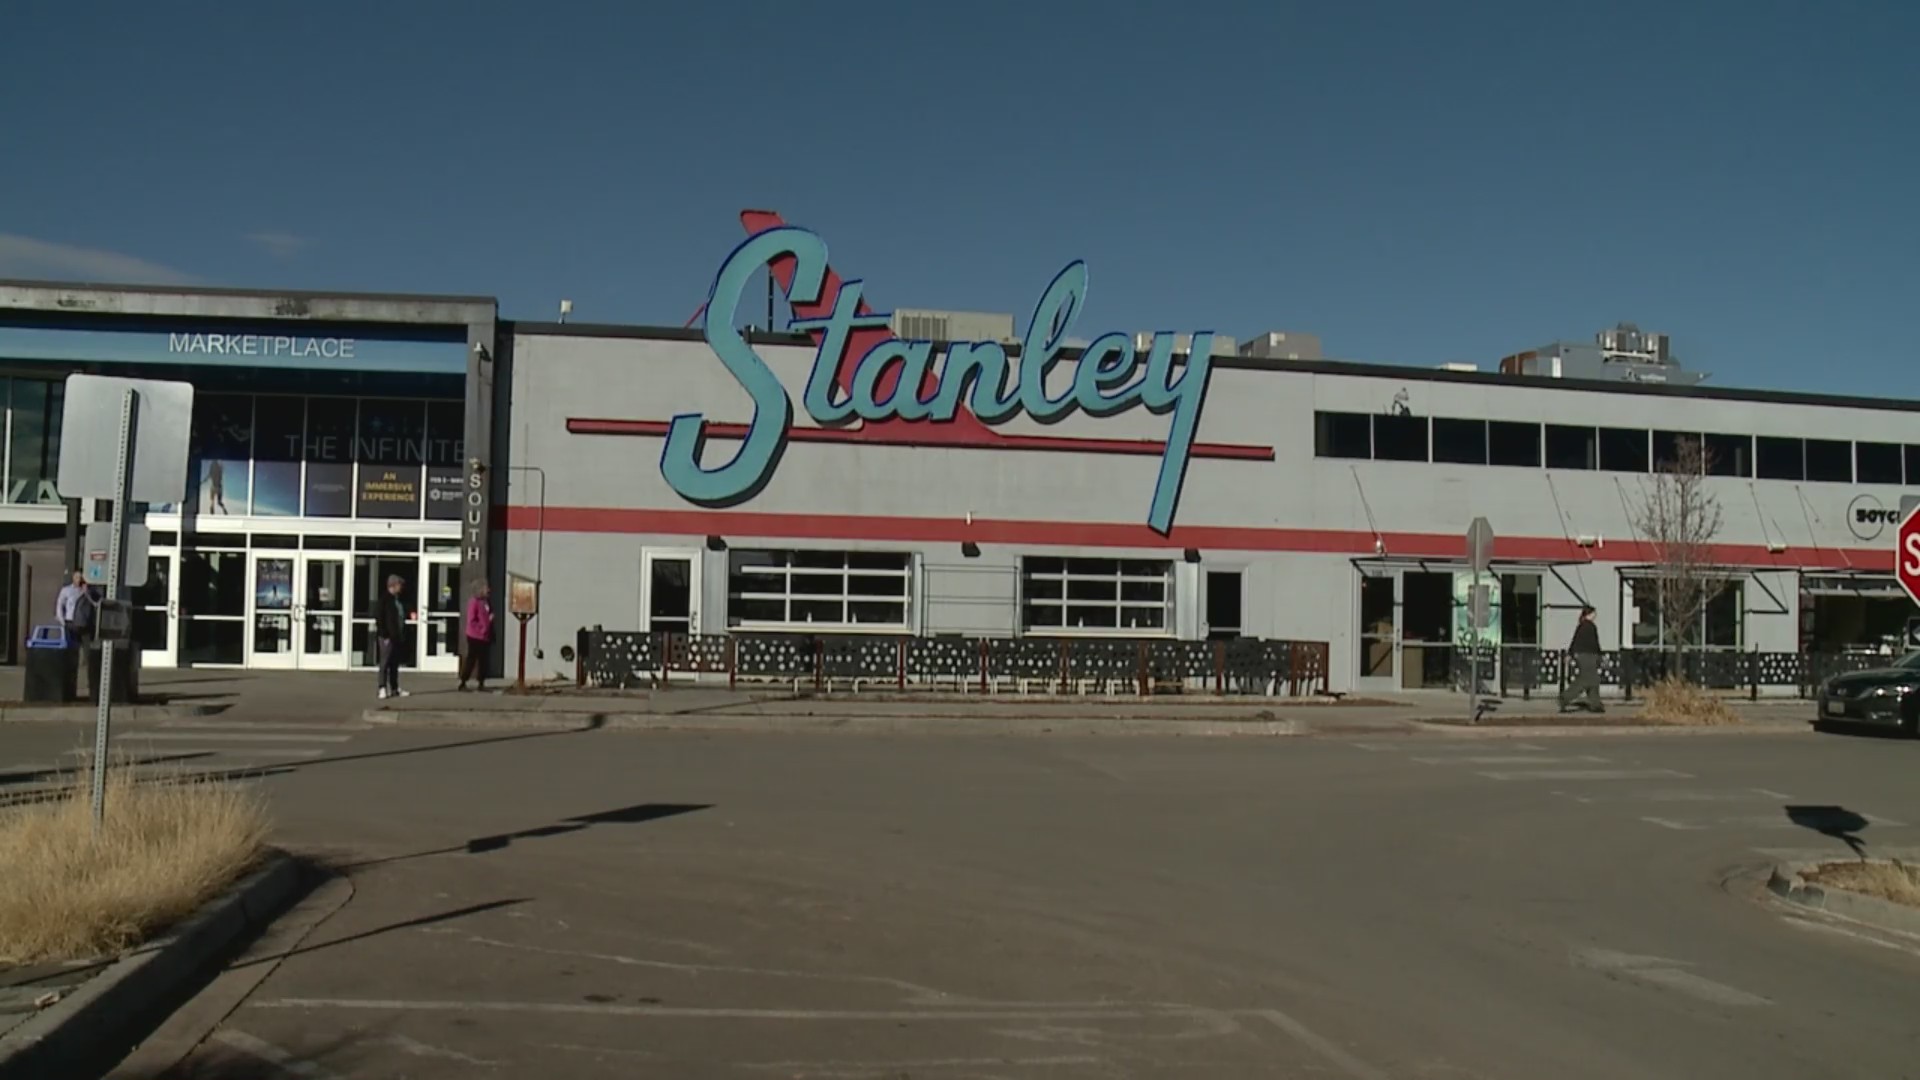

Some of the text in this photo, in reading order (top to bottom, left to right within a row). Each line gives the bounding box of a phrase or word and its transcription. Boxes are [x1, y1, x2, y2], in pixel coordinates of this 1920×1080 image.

[168, 332, 355, 358] MARKETPLACE
[660, 226, 1215, 535] Stanley
[284, 434, 464, 463] THE INFINITE
[364, 481, 413, 492] IMMERSIVE
[383, 471, 397, 481] AN
[362, 492, 416, 502] EXPERIENCE
[467, 473, 483, 561] SOUTH
